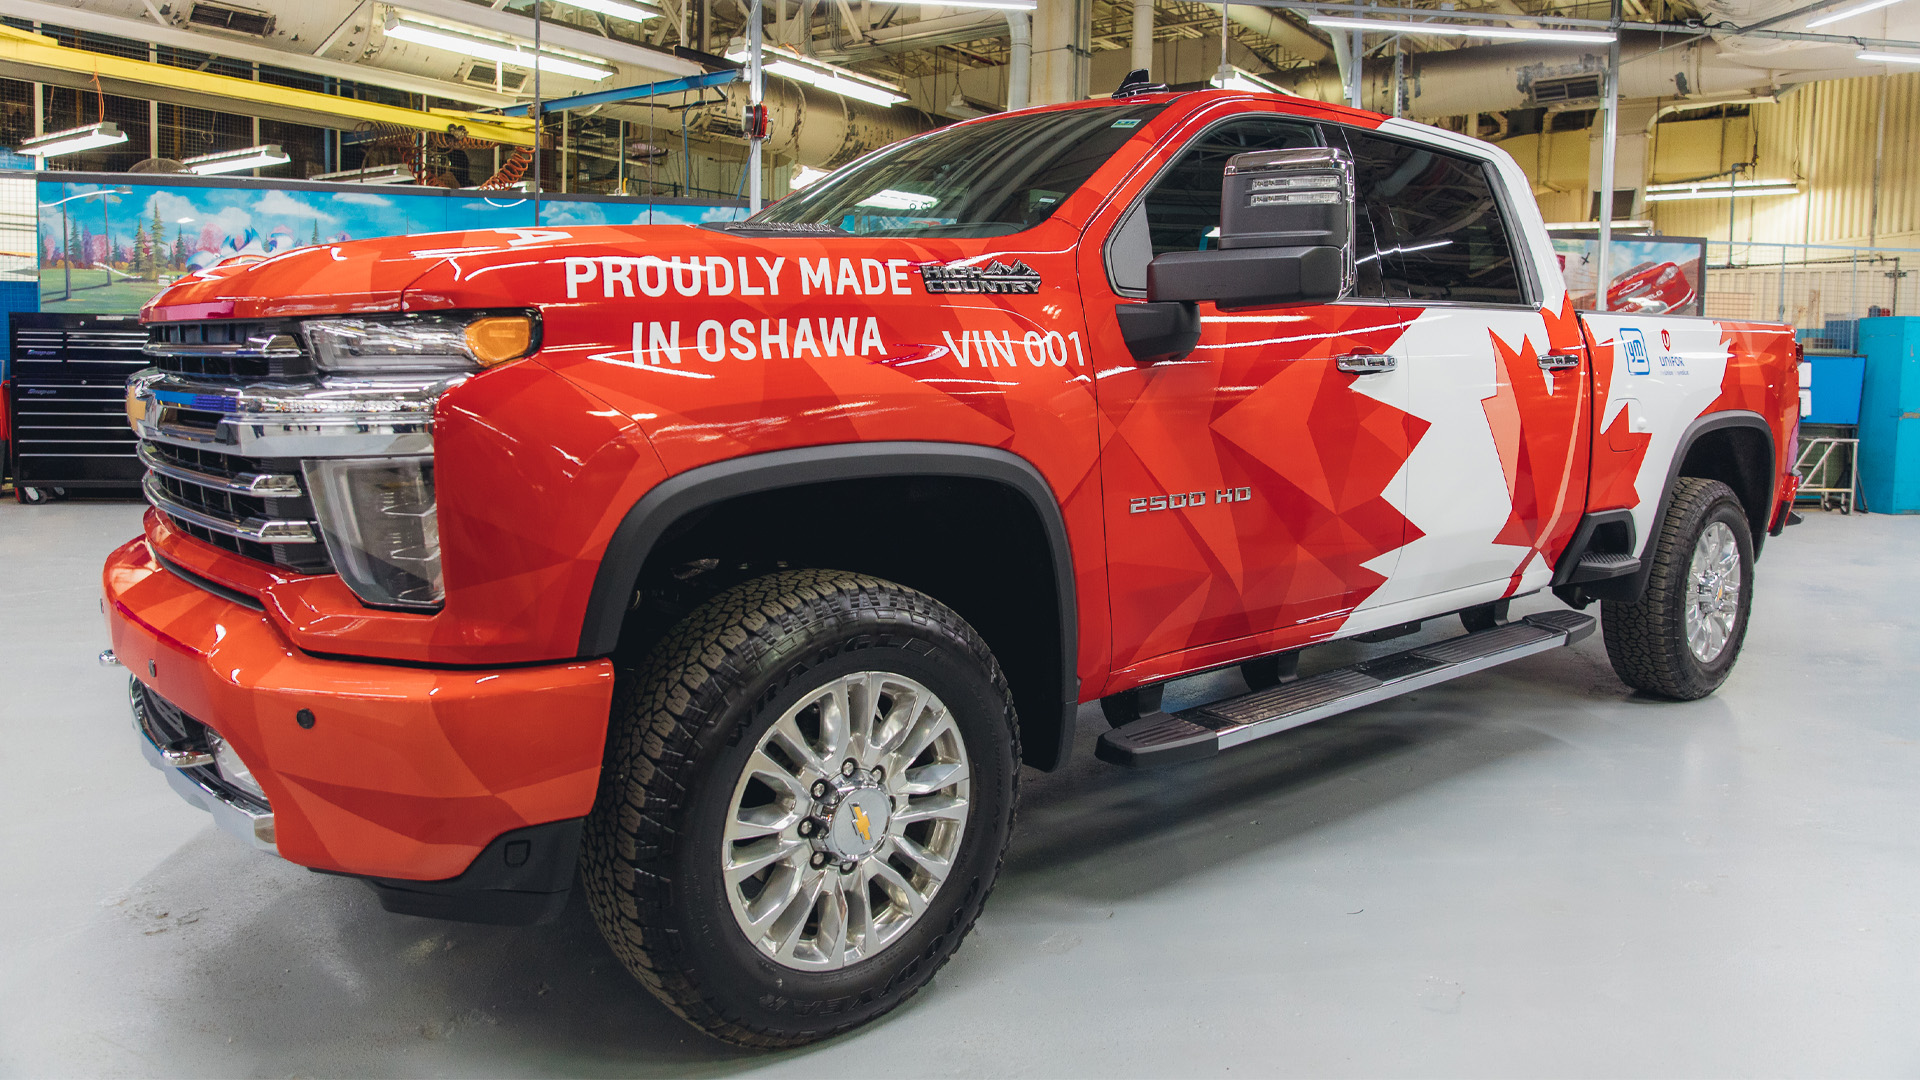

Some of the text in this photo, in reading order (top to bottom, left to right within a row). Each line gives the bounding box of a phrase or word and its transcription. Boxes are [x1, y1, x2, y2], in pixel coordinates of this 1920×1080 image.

[565, 256, 912, 298] PROUDLY MADE
[920, 266, 985, 279] HIGH
[924, 280, 1042, 293] COUNTRY
[632, 317, 888, 366] IN OSHAWA
[941, 330, 1085, 368] VIN 001
[1130, 486, 1252, 514] 2500 HD
